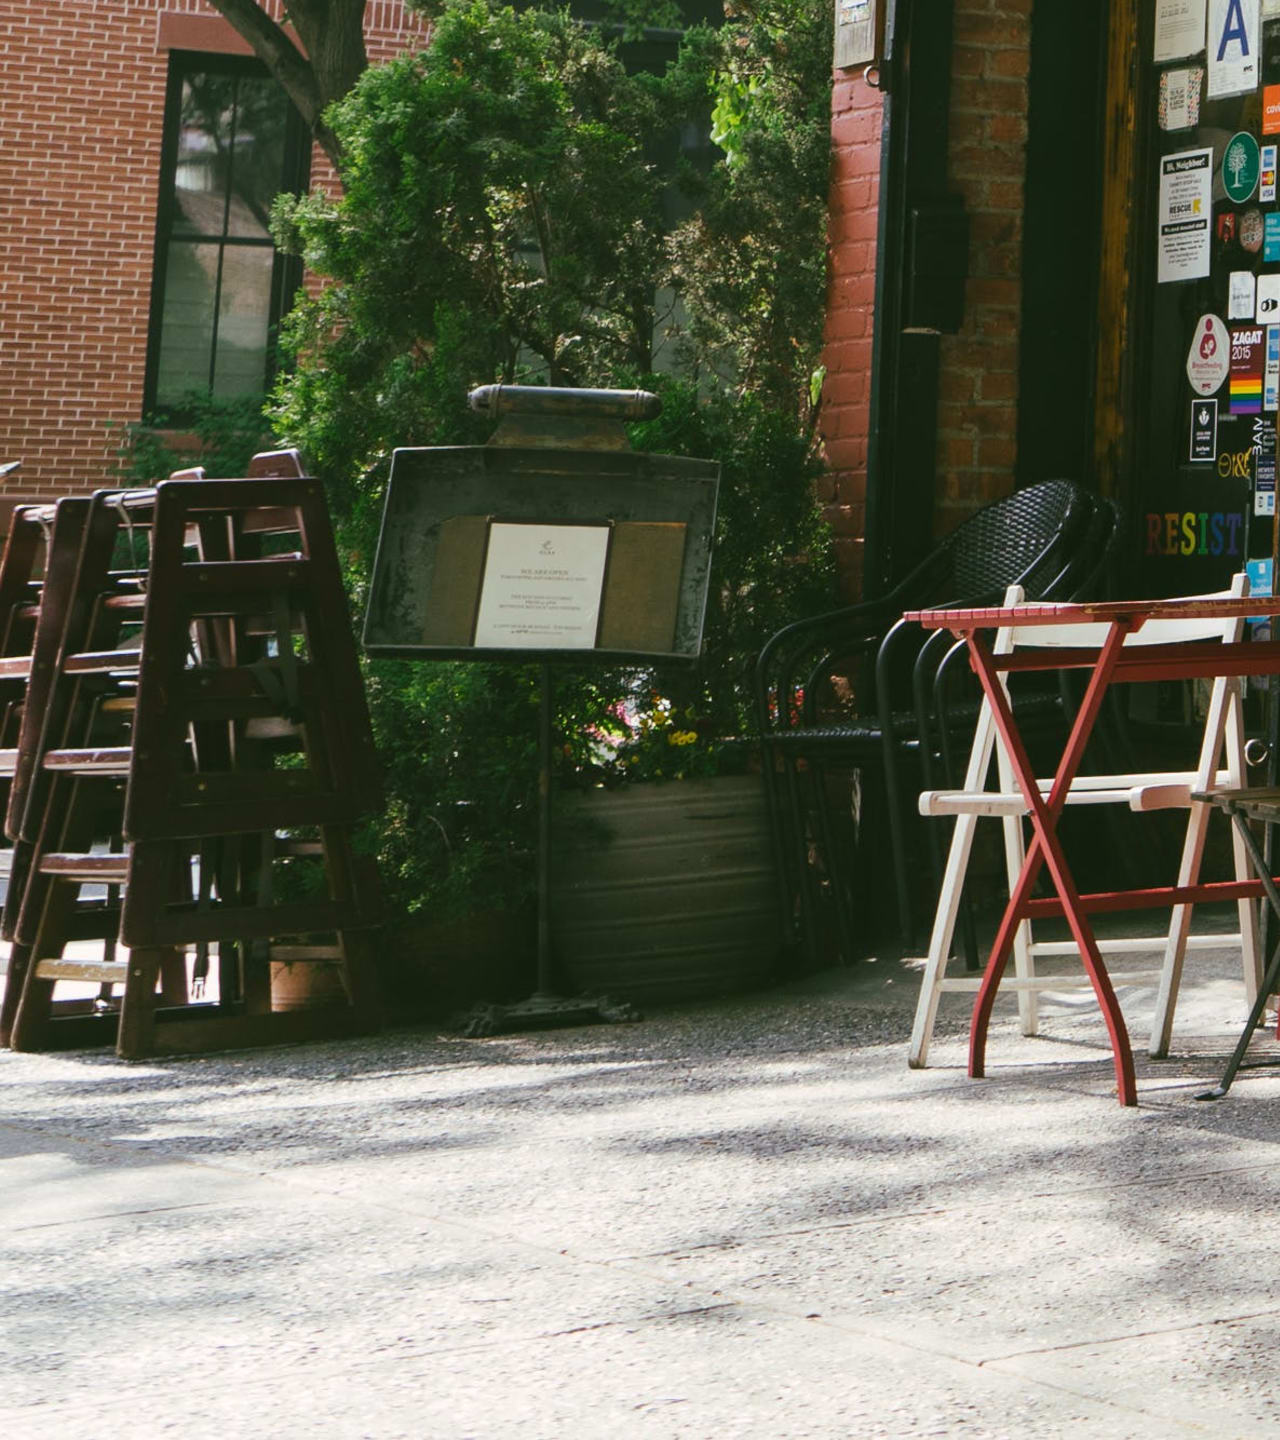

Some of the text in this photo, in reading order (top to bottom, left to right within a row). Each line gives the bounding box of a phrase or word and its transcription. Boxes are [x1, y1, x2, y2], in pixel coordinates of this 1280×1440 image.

[1169, 203, 1192, 215] RESCUE
[1232, 331, 1263, 346] ZAGAT
[1231, 346, 1251, 360] 2015
[1145, 512, 1242, 555] RESIST
